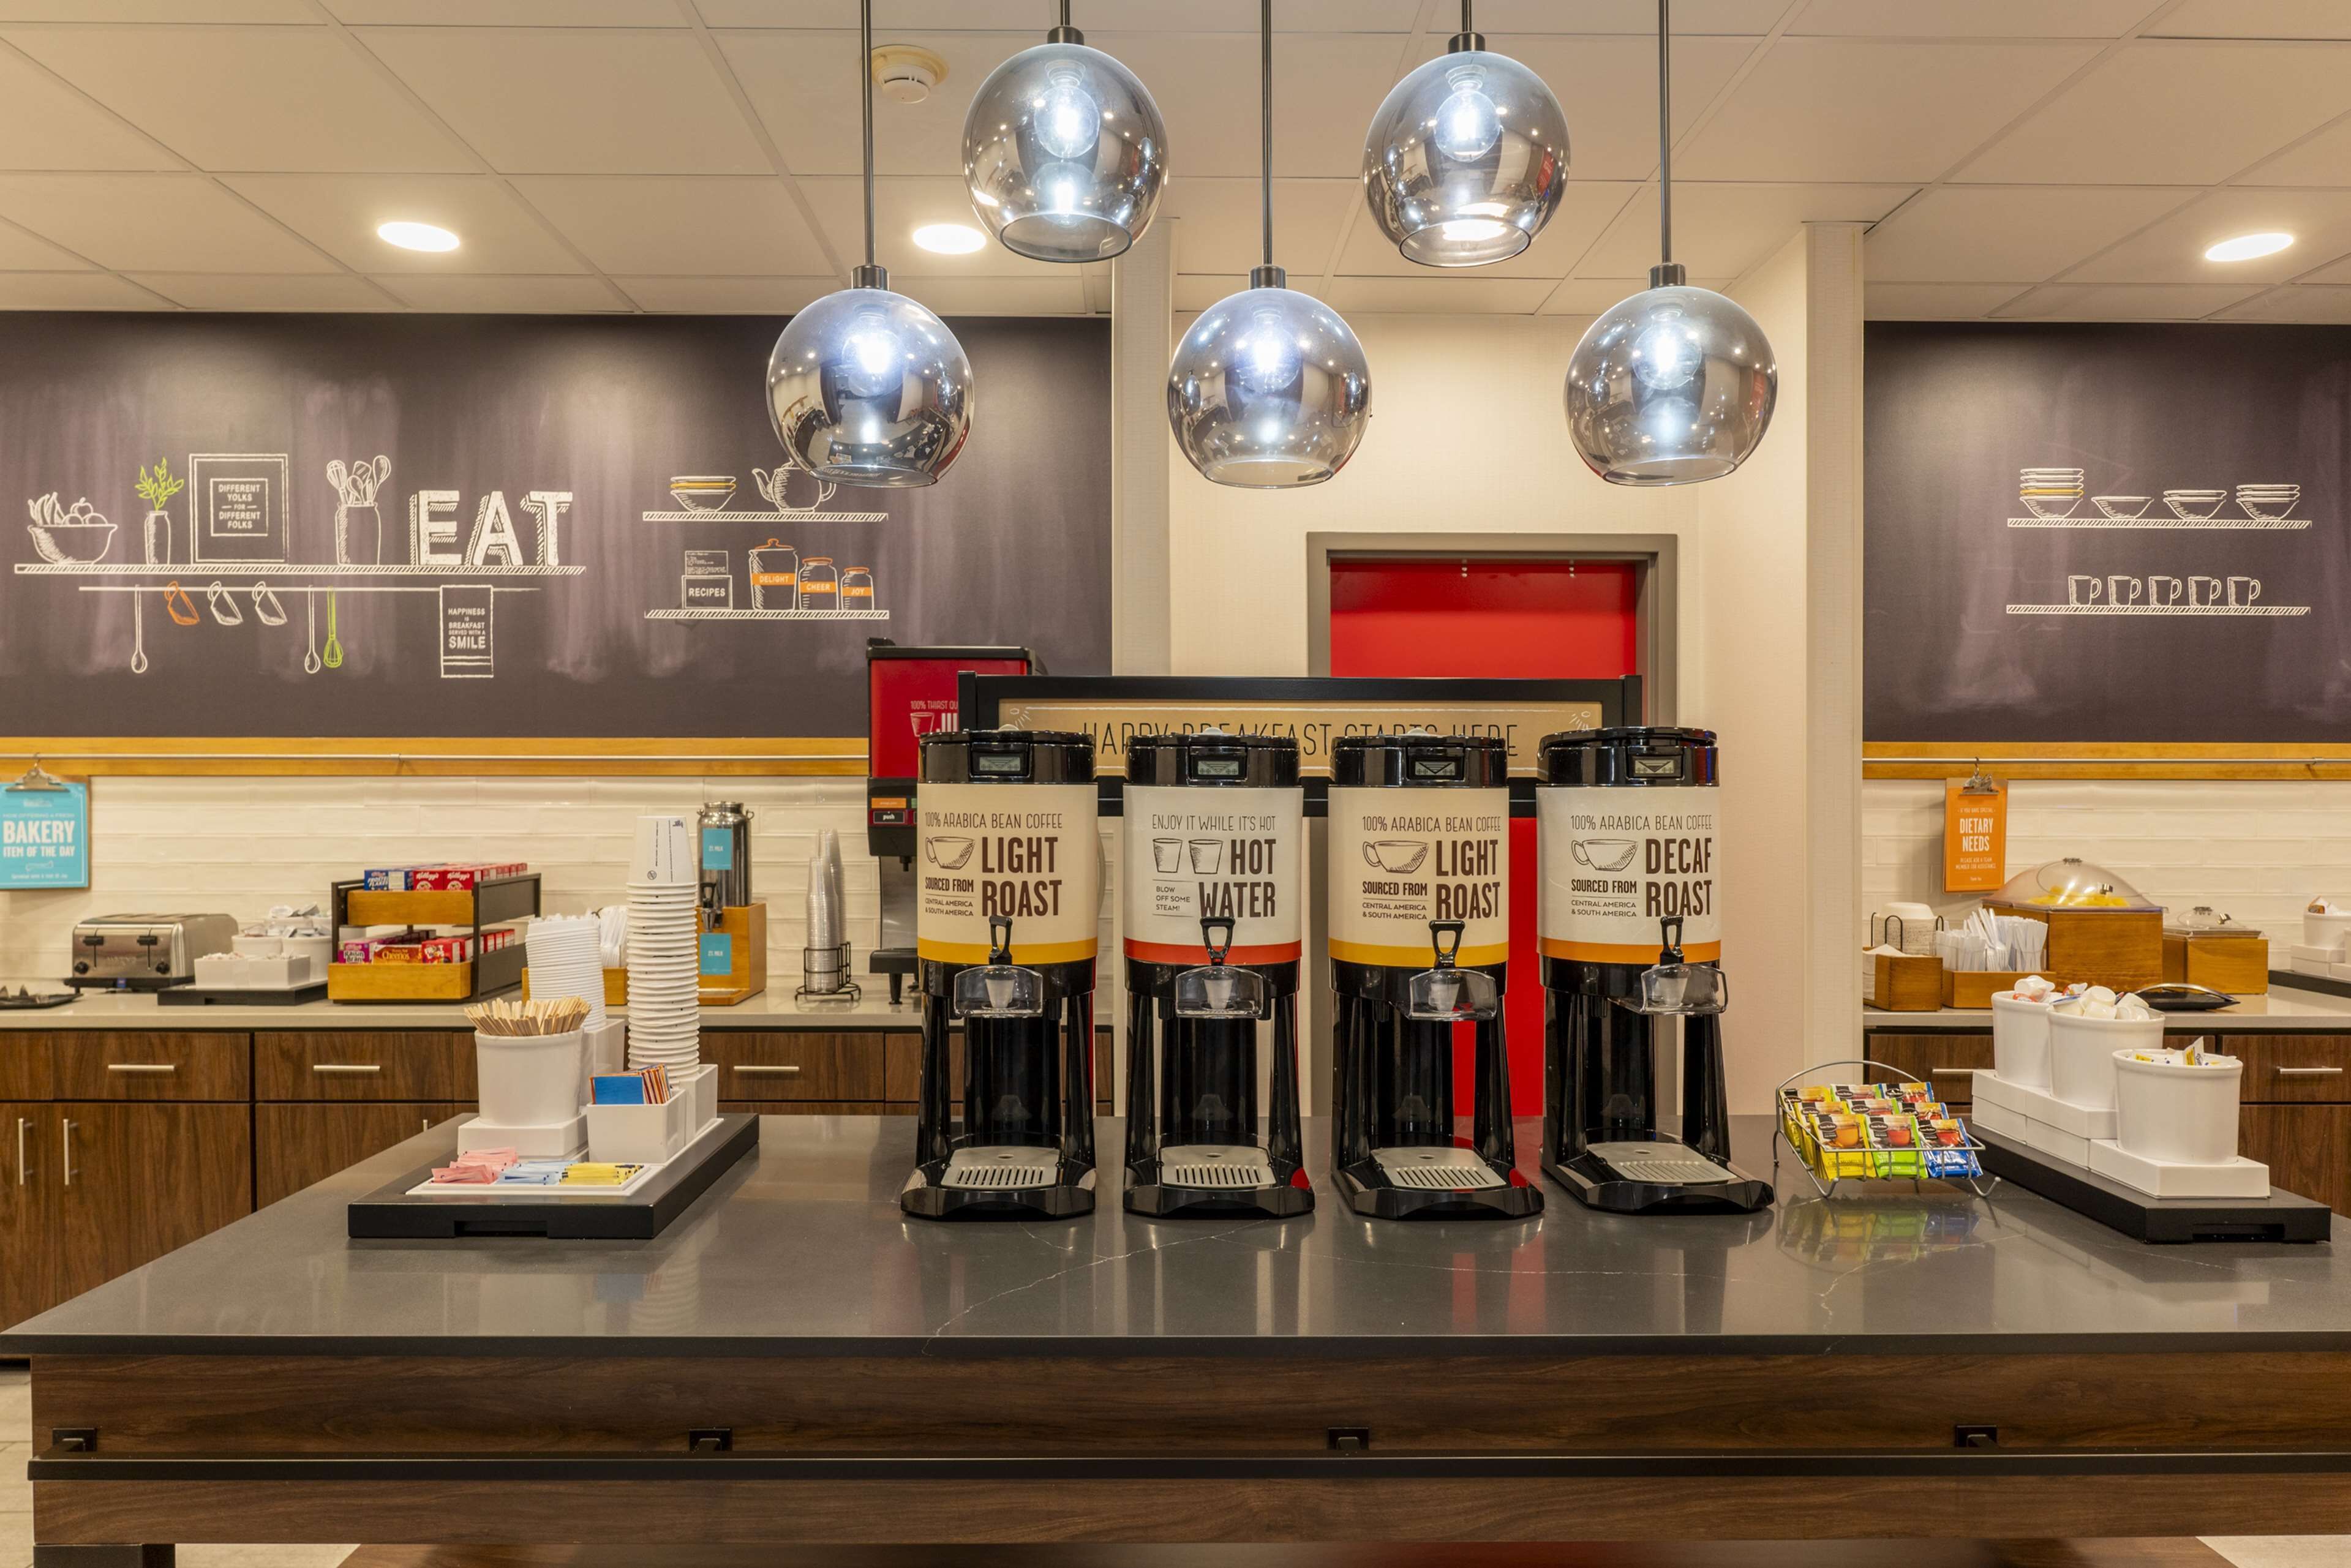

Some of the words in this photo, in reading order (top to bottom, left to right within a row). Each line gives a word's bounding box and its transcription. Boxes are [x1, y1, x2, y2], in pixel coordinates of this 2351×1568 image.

[218, 484, 260, 493] DIFFERENT
[227, 493, 252, 501] YOLKS
[219, 511, 261, 520] DIFFERENT
[227, 520, 252, 529] FOLKS
[410, 490, 573, 565] EAT
[688, 588, 726, 597] RECIPES
[448, 607, 486, 616] HAPPINESS
[449, 636, 486, 650] SMILE
[911, 700, 926, 710] 100%
[927, 700, 948, 710] THIRST
[925, 812, 941, 827] 100%
[943, 812, 987, 828] ARABICA
[991, 813, 1021, 828] BEAN
[1026, 813, 1063, 828] COFFEE
[1153, 814, 1183, 830] ENJOY
[1186, 815, 1195, 830] IT
[1198, 816, 1234, 831] WHILE
[1239, 816, 1256, 831] IT'S
[1260, 816, 1276, 831] HOT
[1363, 816, 1387, 831] 100%
[1391, 817, 1441, 832] ARABICA
[1446, 817, 1472, 832] BEAN
[1476, 816, 1501, 831] COFFEE
[1571, 815, 1596, 830] 100%
[1600, 816, 1650, 830] ARABICA
[1655, 816, 1682, 830] BEAN
[1687, 815, 1712, 830] COFFEE
[1960, 818, 1993, 833] DIETARY
[2, 820, 75, 844] BAKERY
[3, 846, 24, 857] ITEM
[27, 846, 37, 857] OF
[40, 846, 56, 857] THE
[59, 846, 75, 857] DAY
[1962, 836, 1990, 852] NEEDS
[982, 836, 1058, 873] LIGHT
[1230, 839, 1276, 875] HOT
[1436, 839, 1498, 876] LIGHT
[1646, 838, 1712, 874] DECAF
[925, 877, 949, 891] SOURCED
[952, 879, 974, 892] FROM
[1363, 881, 1399, 895] SOURCED
[1403, 882, 1428, 896] FROM
[1571, 879, 1608, 893] SOURCED
[1612, 880, 1637, 893] FROM
[925, 898, 944, 906] CENTRAL
[982, 880, 1062, 917] ROAST
[1198, 882, 1276, 918] WATER
[1436, 882, 1500, 919] ROAST
[1646, 880, 1712, 917] ROAST
[382, 951, 410, 961] Cheerios
